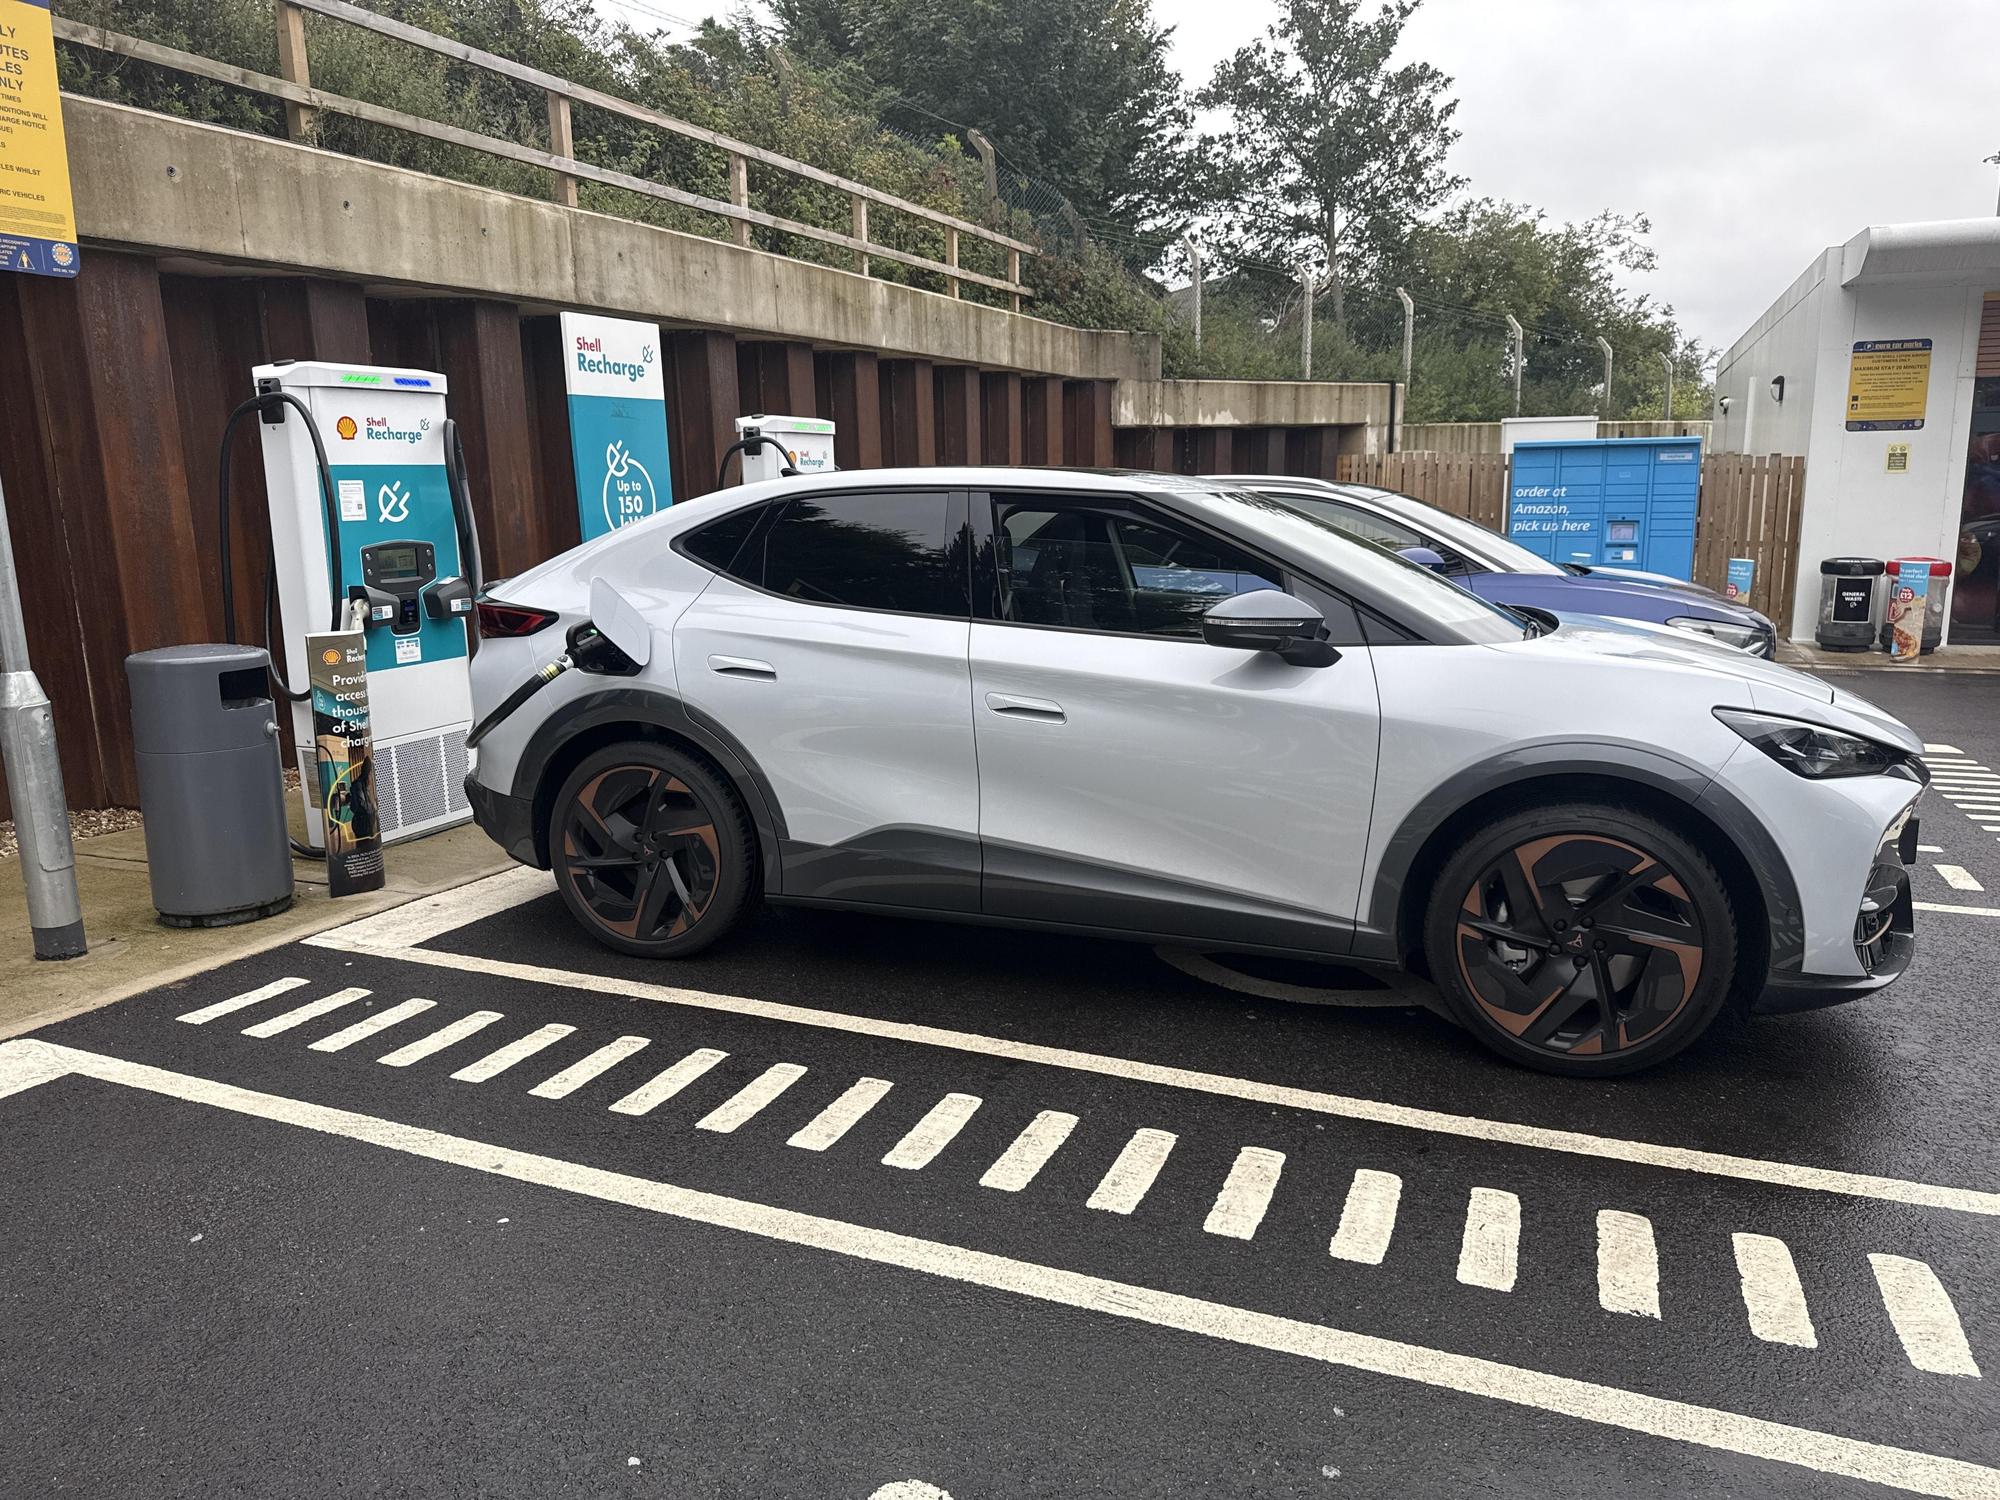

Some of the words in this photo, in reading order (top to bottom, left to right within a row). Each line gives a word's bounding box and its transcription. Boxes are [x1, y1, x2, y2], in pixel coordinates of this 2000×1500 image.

[1, 93, 21, 103] TIMES
[32, 112, 48, 121] WILL
[22, 120, 47, 130] NOTICE
[0, 163, 14, 171] LES
[15, 166, 40, 176] WHILST
[12, 190, 45, 201] VEHICLES
[576, 336, 601, 352] Shell
[577, 352, 644, 382] Recharge
[366, 416, 387, 427] Shell
[366, 427, 422, 444] Recharge
[800, 458, 824, 467] Recharge
[616, 480, 630, 494] Up
[632, 480, 642, 492] to
[1516, 486, 1550, 497] order
[1552, 486, 1567, 497] at
[618, 496, 643, 514] 150
[1514, 504, 1570, 516] Amazon,
[1513, 520, 1538, 534] pick
[1540, 522, 1559, 533] up
[1562, 520, 1590, 532] here
[332, 720, 346, 734] of
